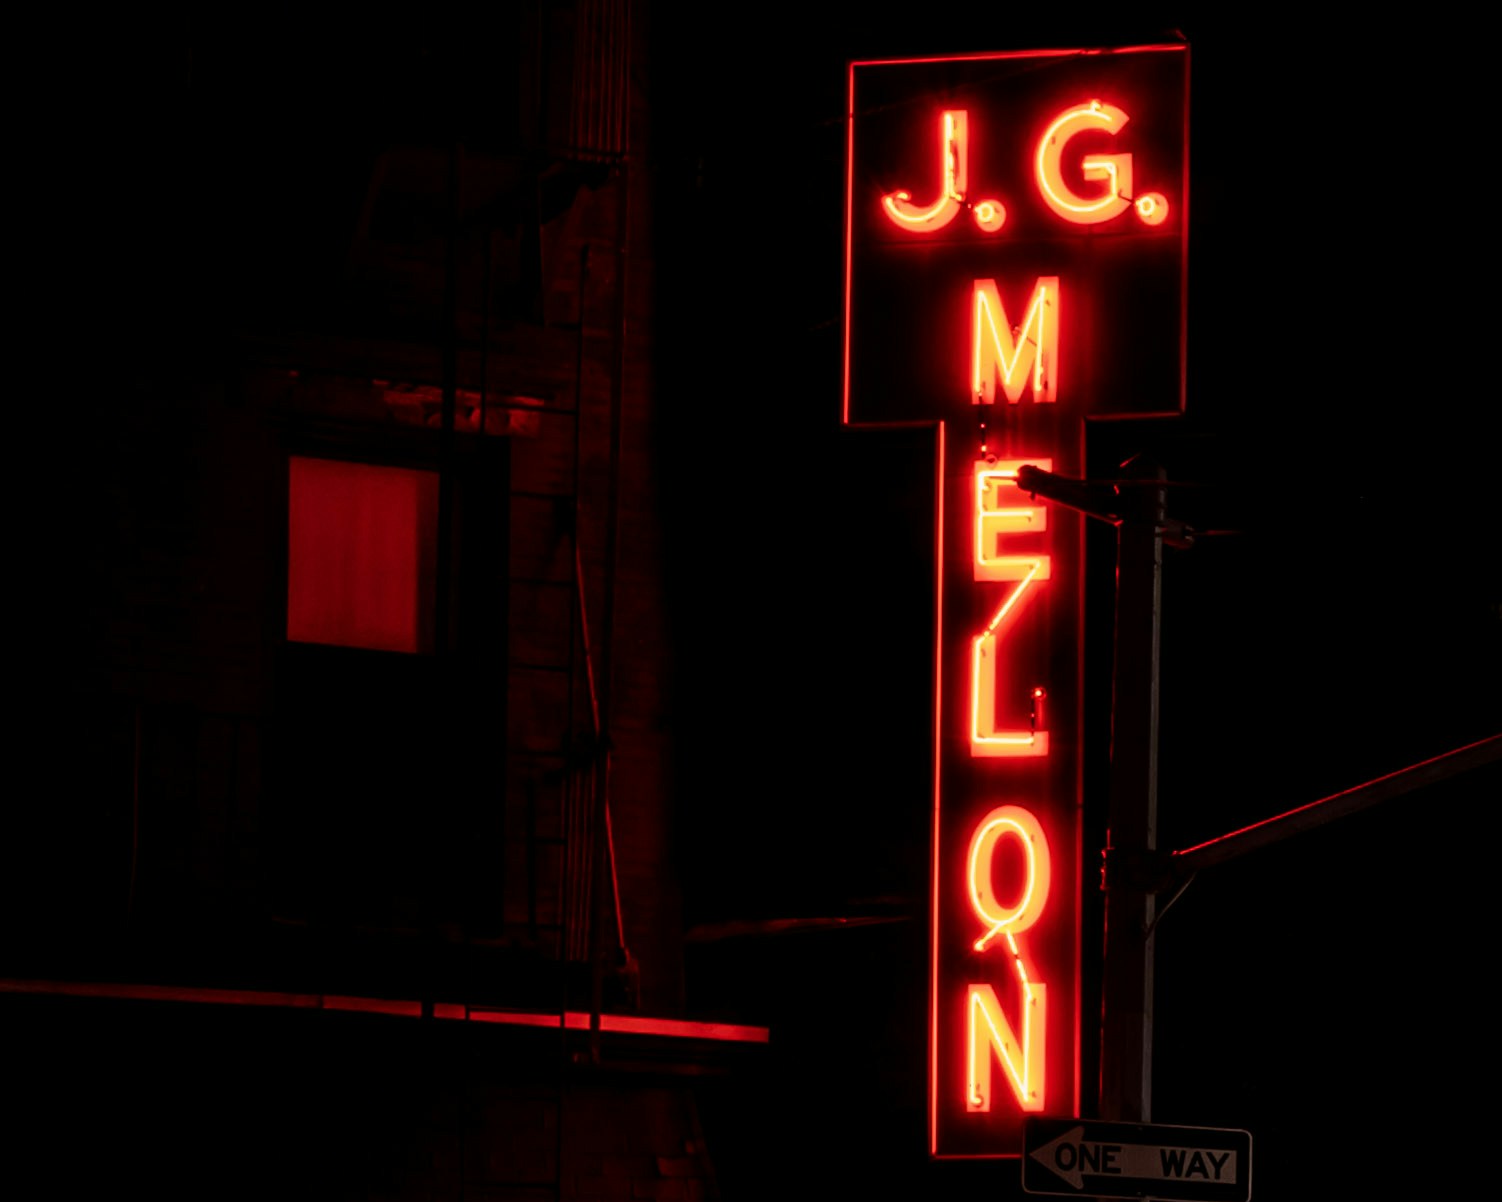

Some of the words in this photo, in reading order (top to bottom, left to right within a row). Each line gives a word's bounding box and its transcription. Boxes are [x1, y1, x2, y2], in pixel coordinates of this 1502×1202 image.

[882, 109, 1006, 233] J.
[1033, 99, 1169, 225] G.
[966, 275, 1060, 1113] MELON
[1055, 1142, 1122, 1174] ONE
[1160, 1149, 1229, 1180] WAY
